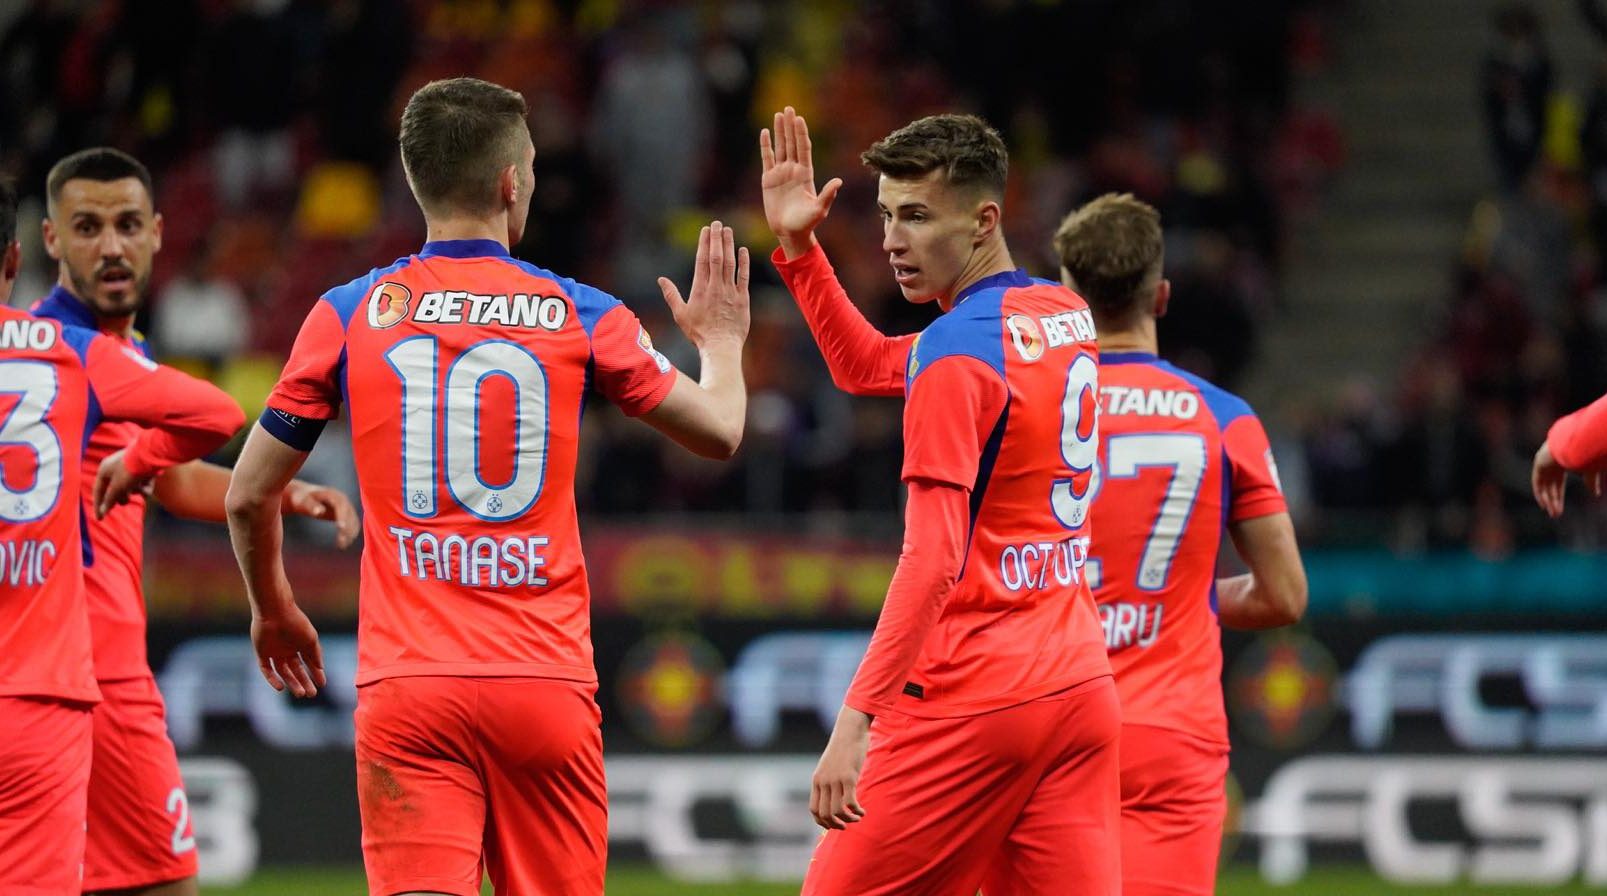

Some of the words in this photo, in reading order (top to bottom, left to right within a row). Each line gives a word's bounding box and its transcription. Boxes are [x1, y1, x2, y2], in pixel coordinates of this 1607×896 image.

[0, 319, 56, 351] NO
[413, 290, 568, 331] BETANO
[0, 359, 63, 523] 3
[384, 335, 549, 522] 10
[1051, 352, 1098, 530] 9
[1098, 385, 1200, 419] TANO
[389, 526, 551, 587] TANASE
[1085, 432, 1208, 591] 7
